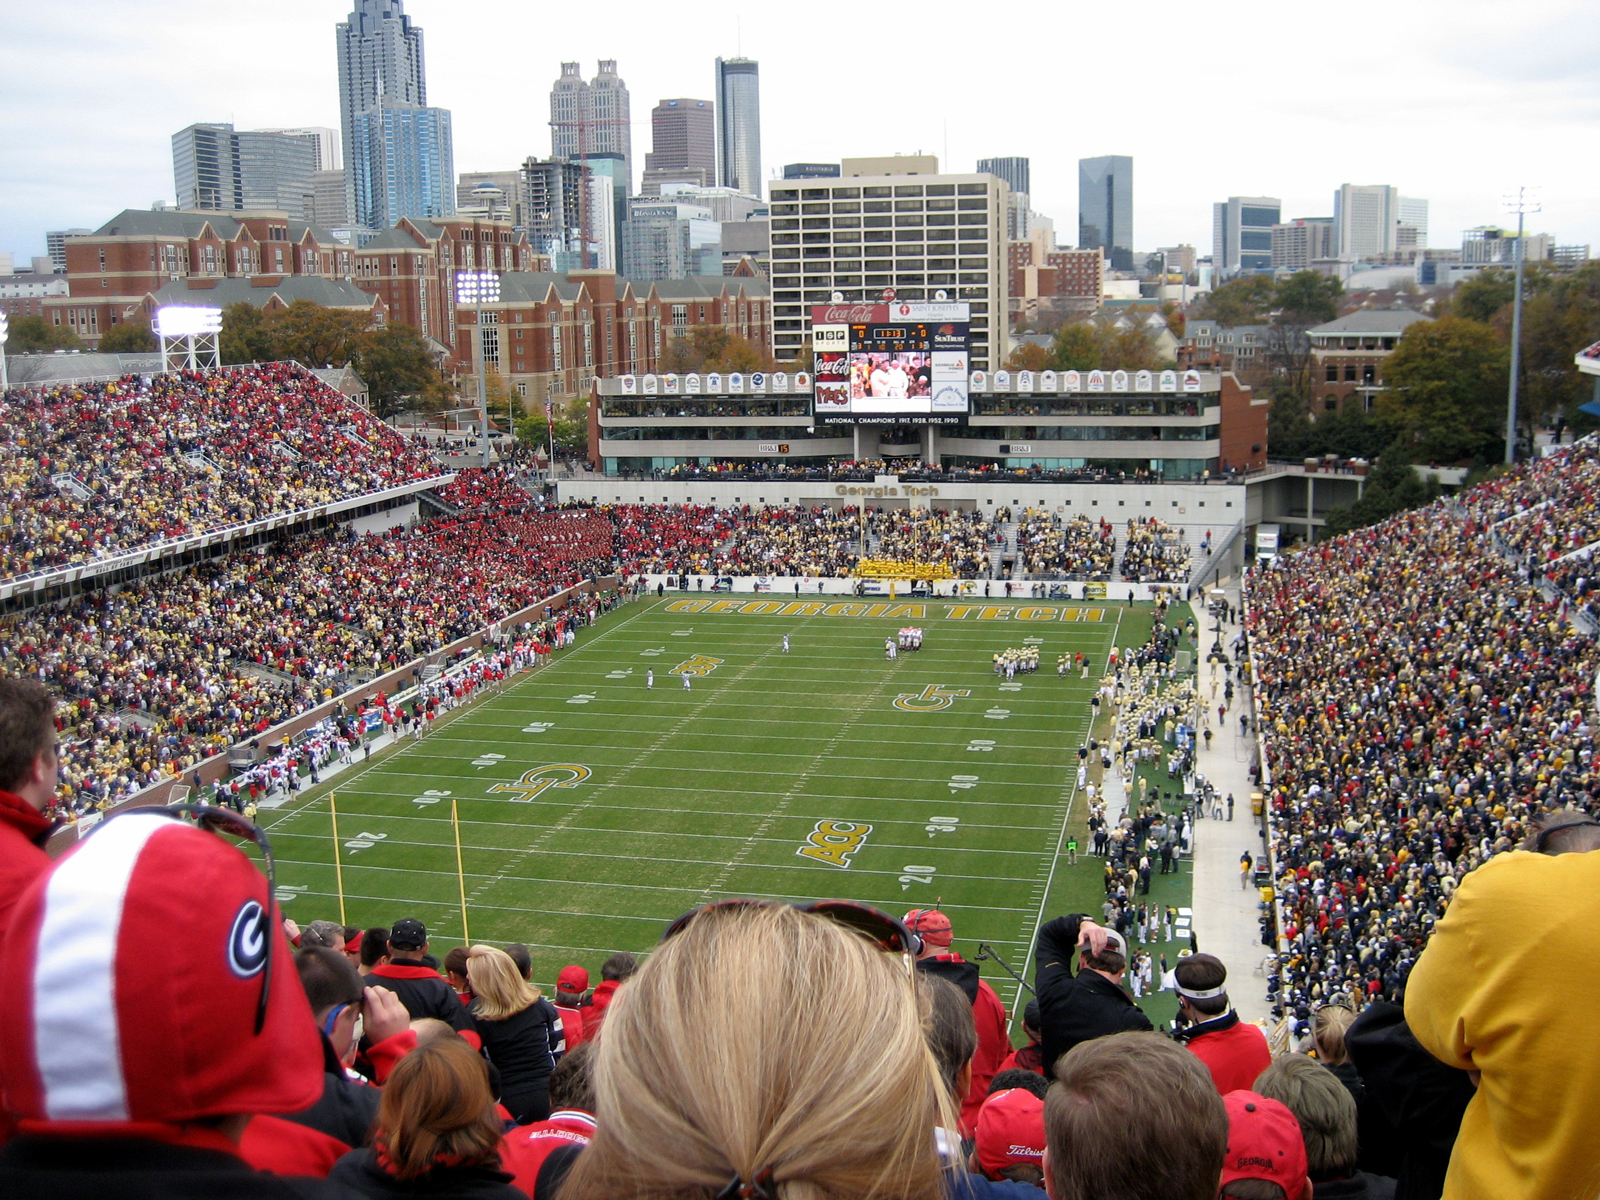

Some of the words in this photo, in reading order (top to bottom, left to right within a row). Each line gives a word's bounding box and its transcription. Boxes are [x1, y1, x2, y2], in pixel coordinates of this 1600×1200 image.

[816, 331, 845, 341] ISP
[835, 484, 898, 498] Georgia
[902, 485, 939, 496] Tech
[664, 600, 926, 618] GEORGIA
[943, 605, 1106, 622] TECH
[898, 865, 937, 884] 20
[1237, 1156, 1276, 1172] GEORGIA
